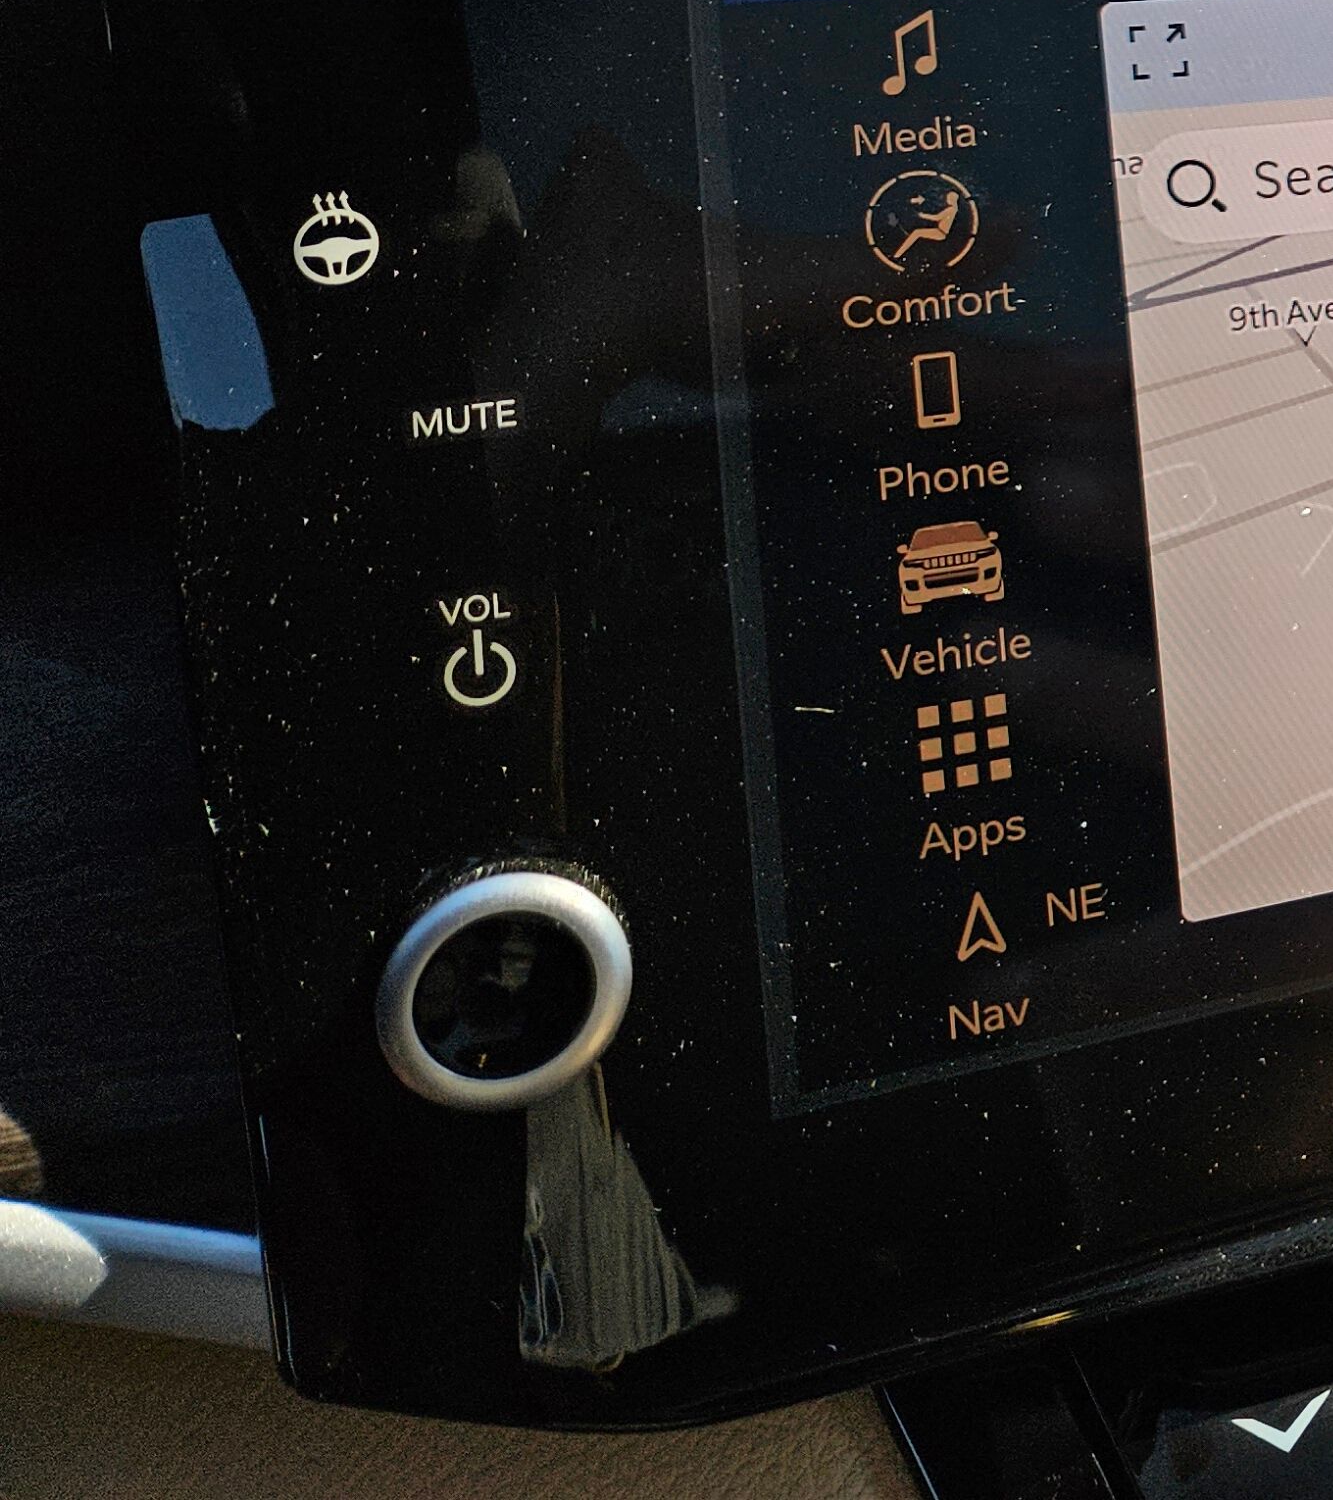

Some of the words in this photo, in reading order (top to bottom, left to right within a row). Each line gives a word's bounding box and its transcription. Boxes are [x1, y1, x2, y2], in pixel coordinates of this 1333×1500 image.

[853, 115, 976, 156] Media
[842, 282, 1016, 330] Comfort
[1229, 302, 1279, 331] 9th
[412, 399, 518, 439] MUTE
[878, 458, 1010, 500] Phone
[438, 593, 511, 626] VOL
[882, 627, 1031, 680] Vehicle
[920, 813, 1027, 861] Apps
[1045, 883, 1106, 927] NE
[949, 997, 1030, 1039] Nav
